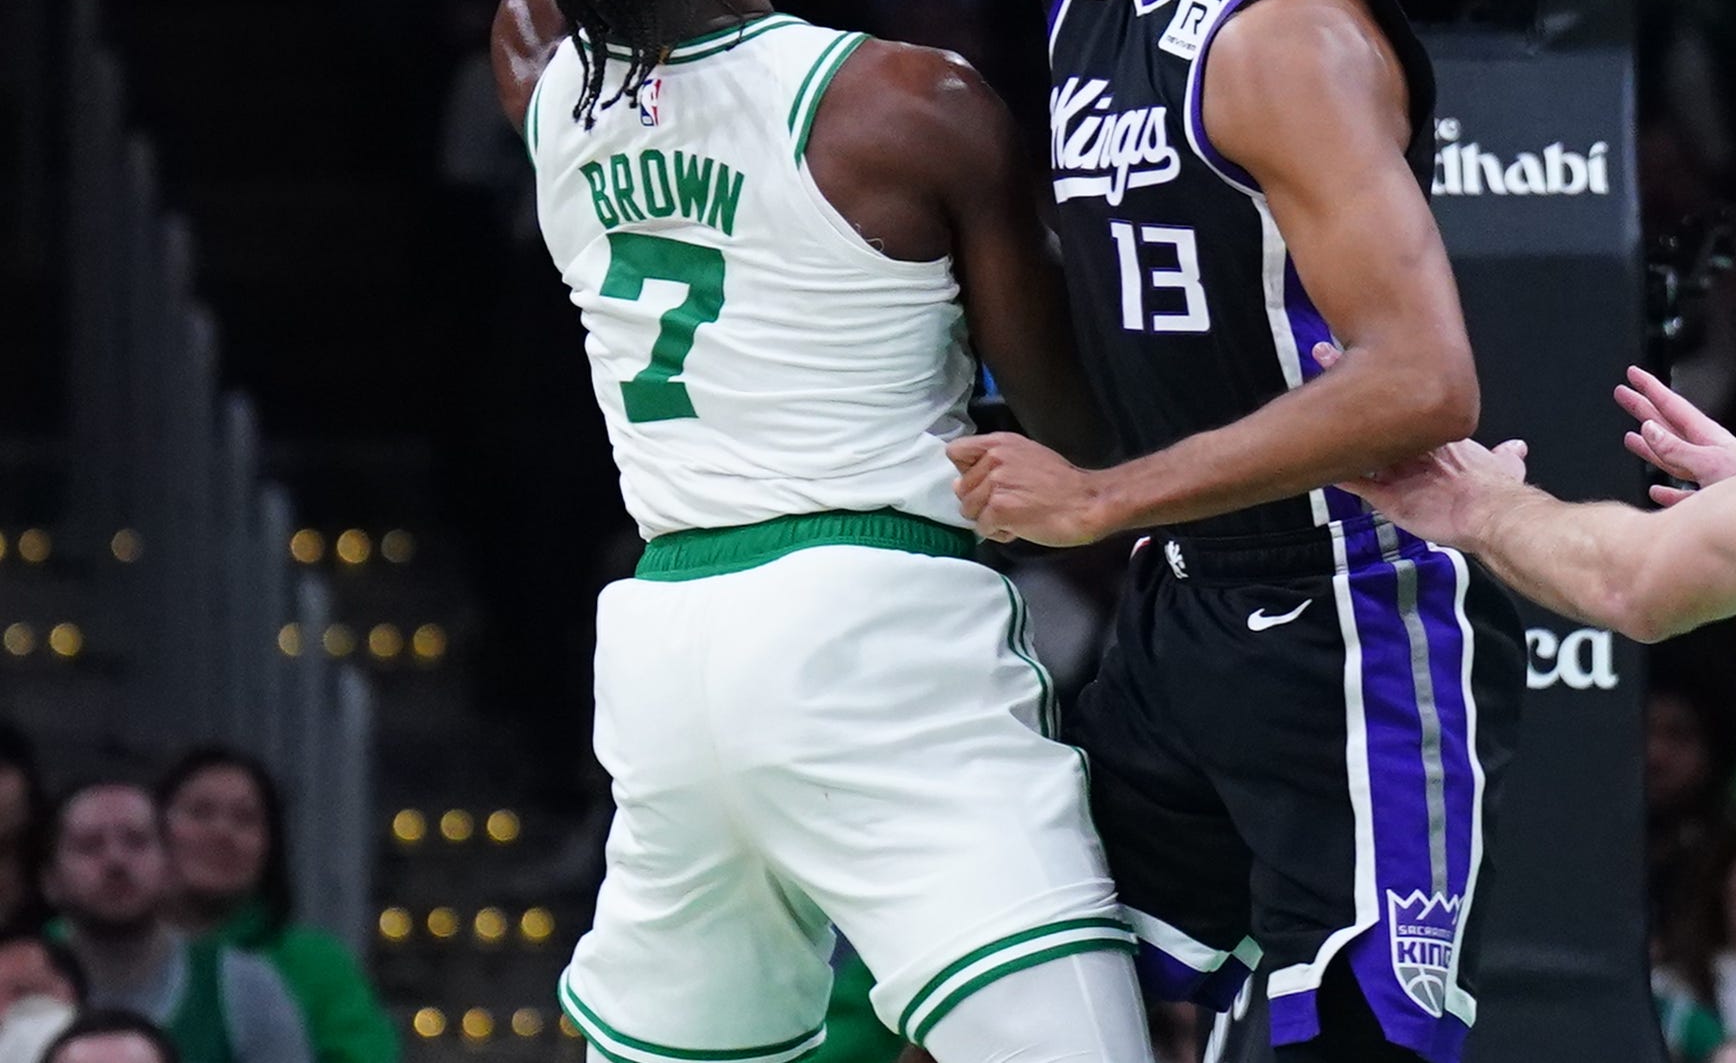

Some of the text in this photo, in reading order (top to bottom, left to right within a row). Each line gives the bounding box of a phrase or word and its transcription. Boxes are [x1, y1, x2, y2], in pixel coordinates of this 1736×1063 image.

[580, 149, 745, 237] BROWN
[1050, 76, 1181, 206] Kings
[600, 233, 727, 424] 7
[1108, 219, 1211, 332] 13
